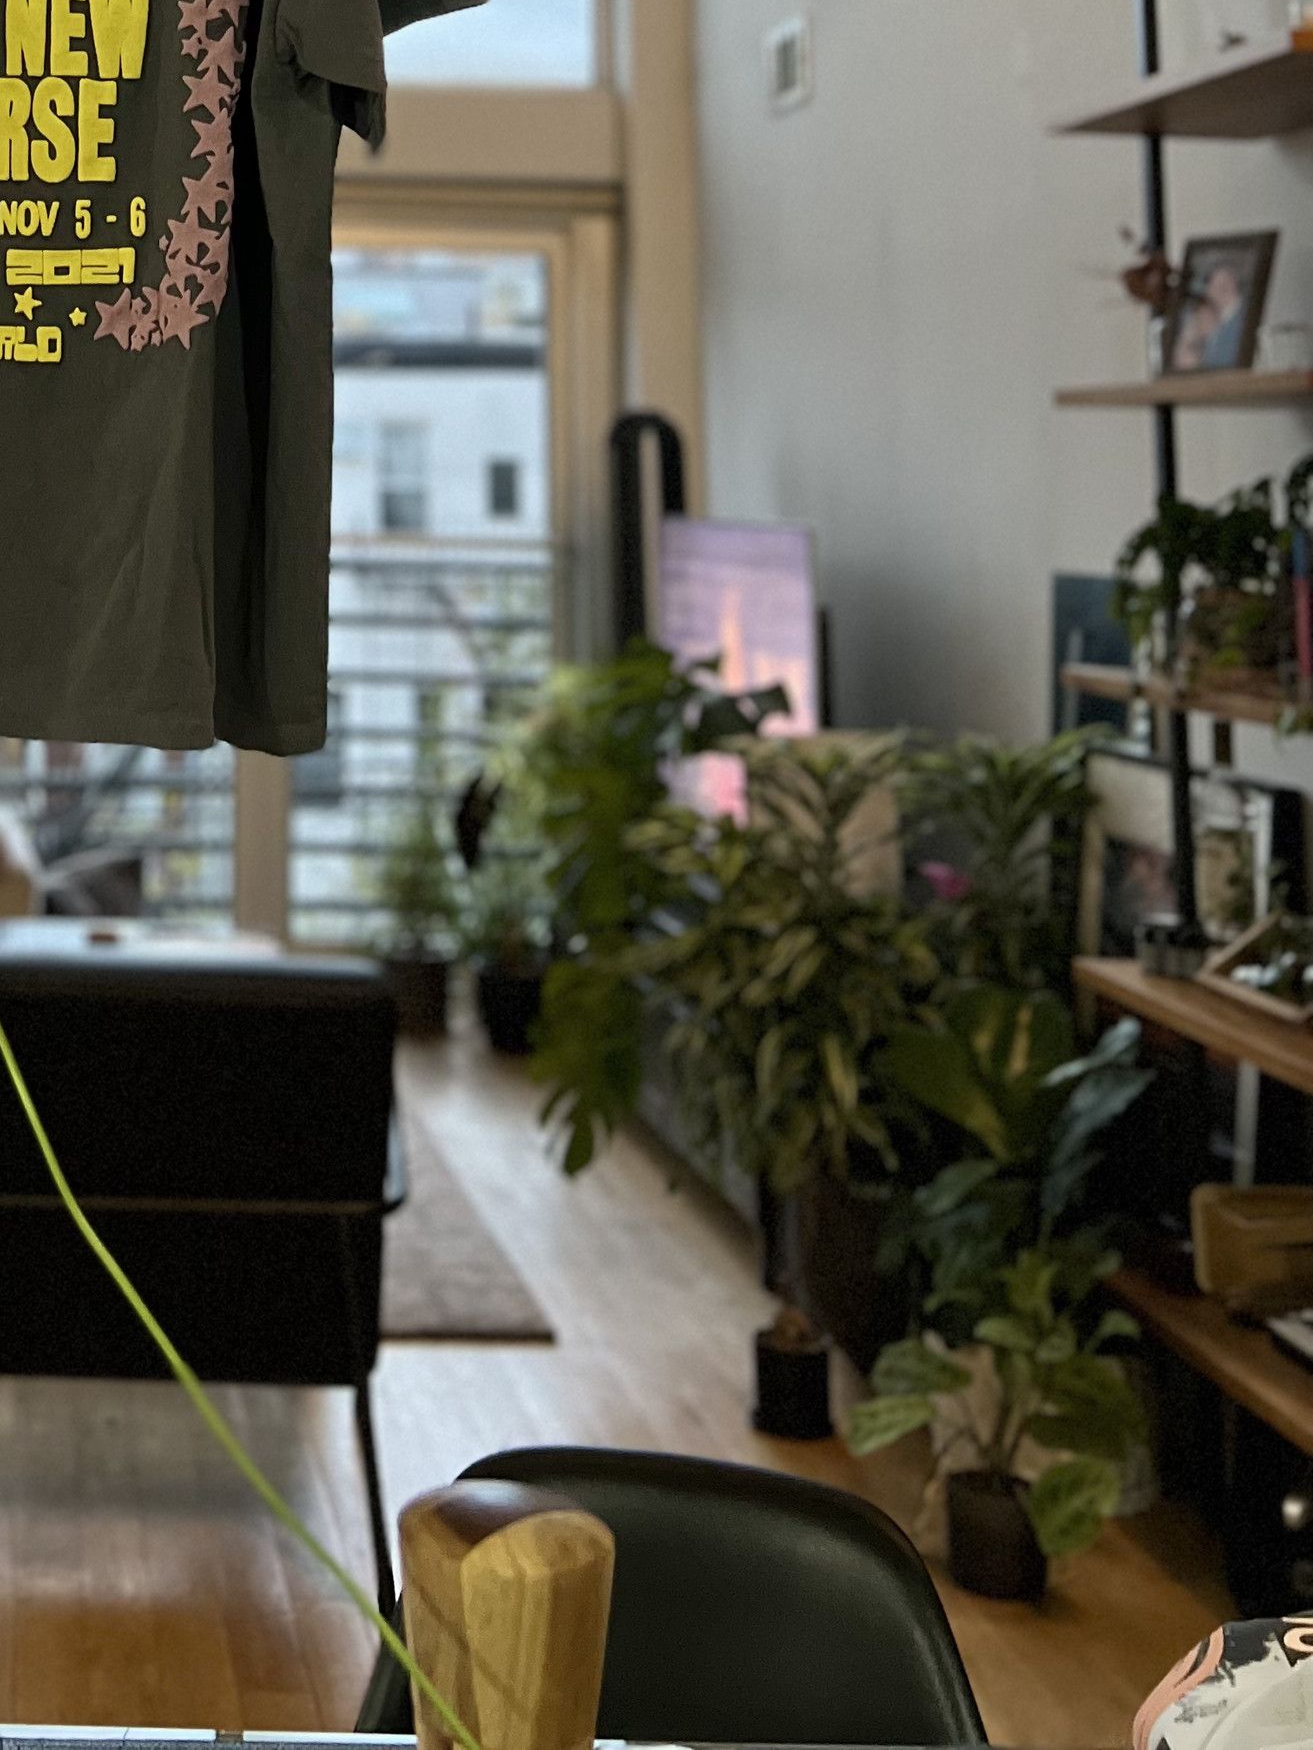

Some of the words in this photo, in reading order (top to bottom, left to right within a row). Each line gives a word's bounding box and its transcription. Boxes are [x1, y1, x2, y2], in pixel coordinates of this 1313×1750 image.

[75, 199, 91, 239] 5
[130, 196, 146, 237] 6
[6, 247, 135, 285] 2021
